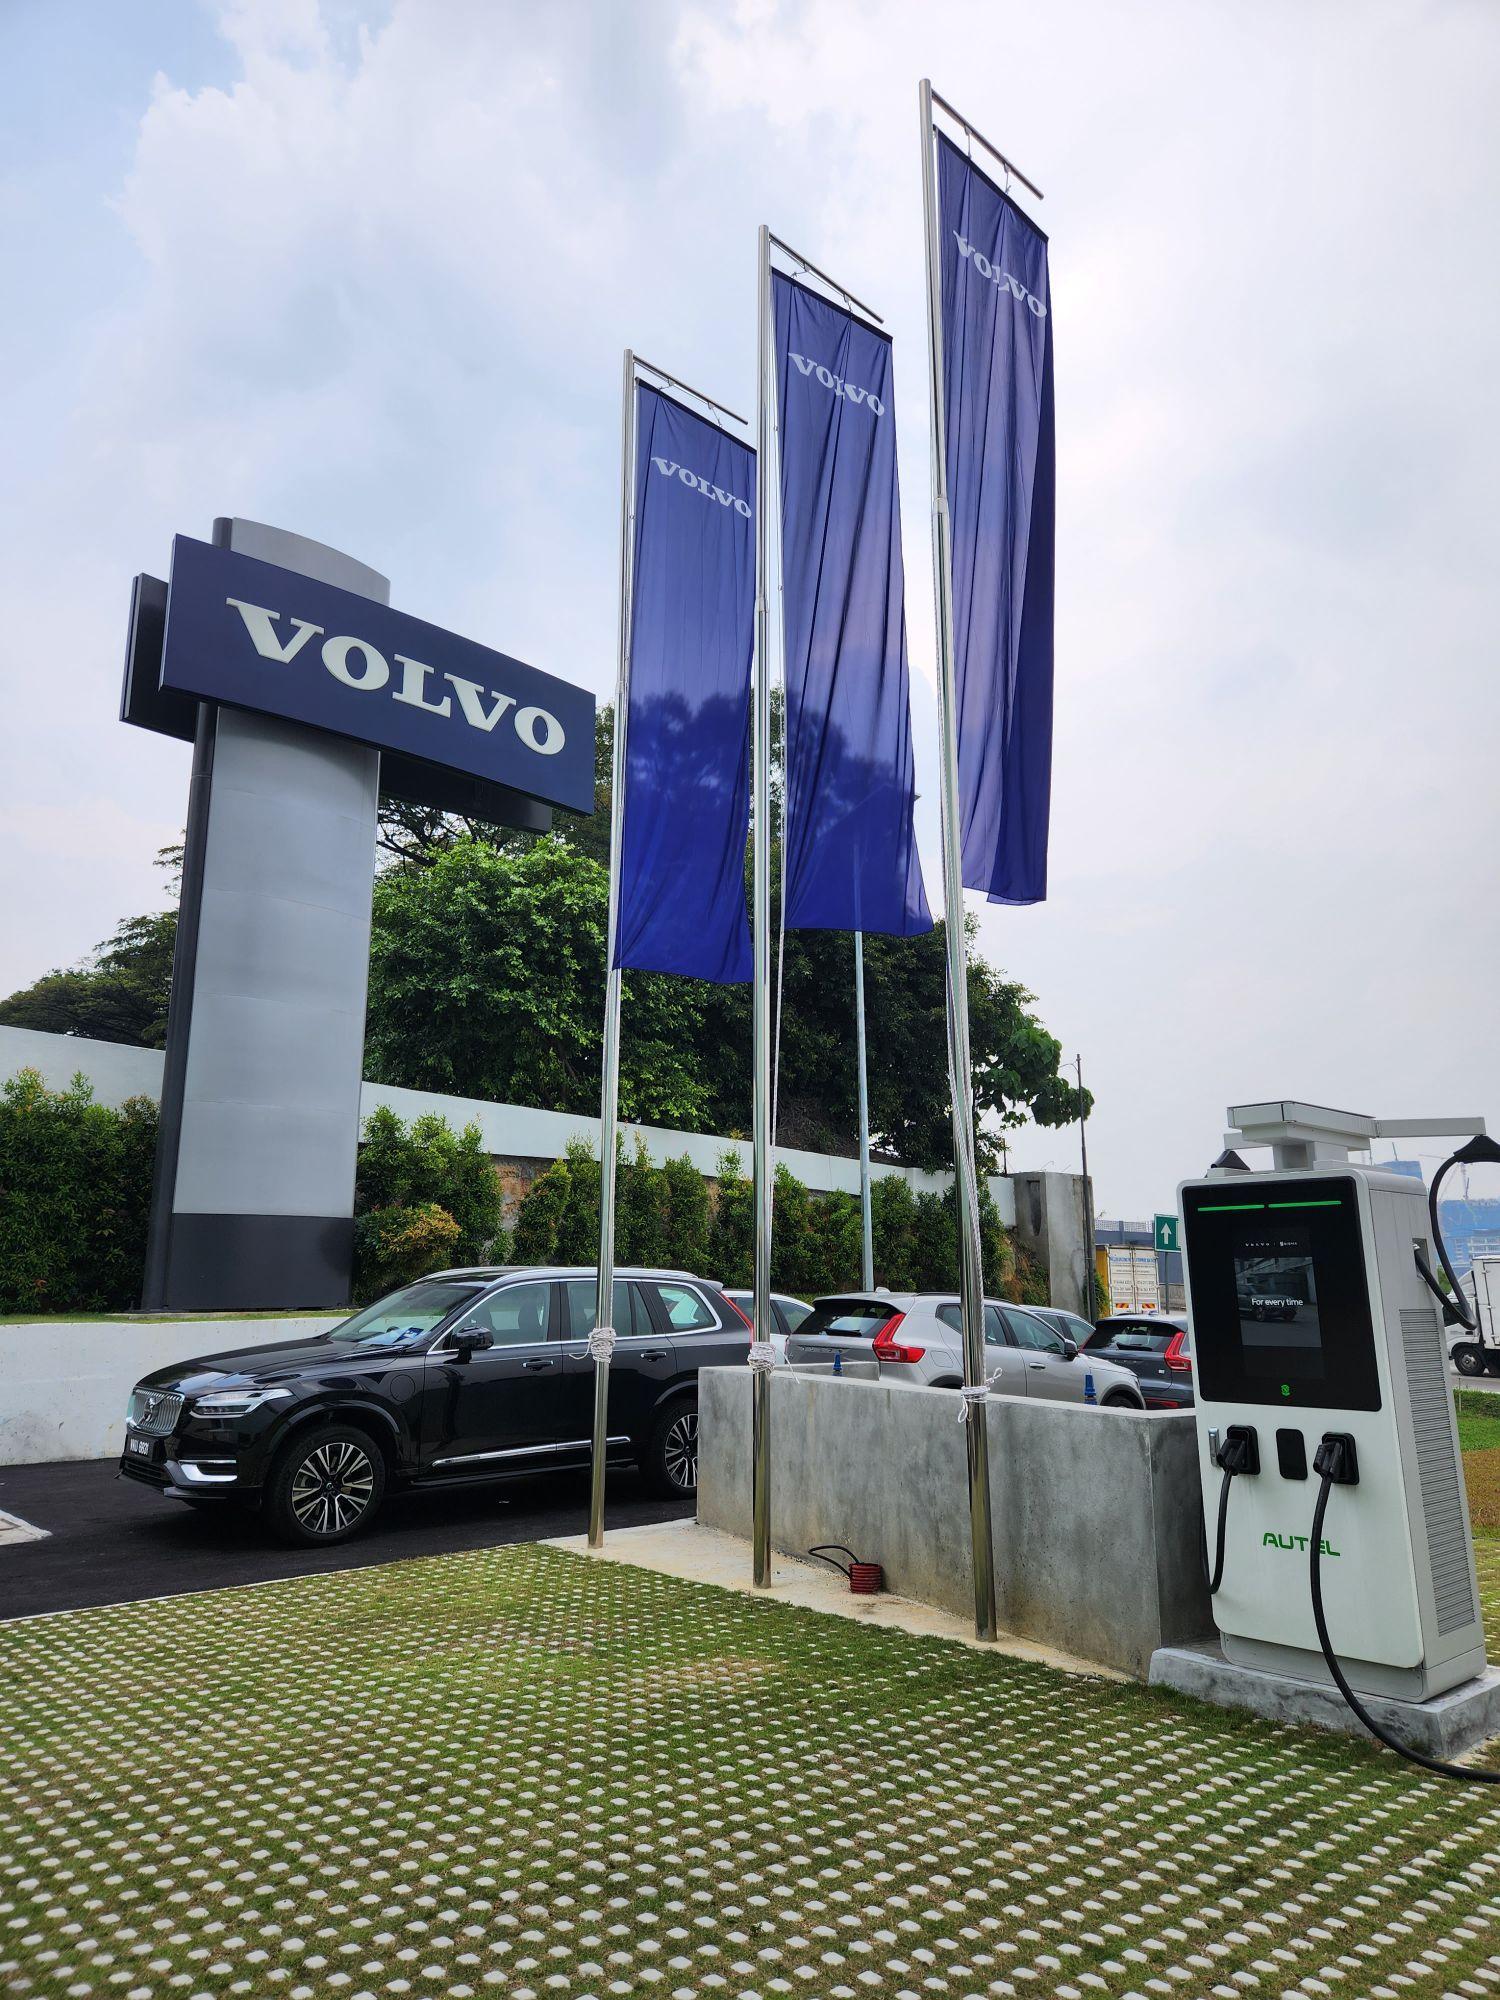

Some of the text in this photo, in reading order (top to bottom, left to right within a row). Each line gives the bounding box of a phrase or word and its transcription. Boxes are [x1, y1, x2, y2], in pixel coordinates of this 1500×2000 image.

[953, 230, 1047, 318] VOLVO
[788, 352, 886, 417] VOLVO
[650, 456, 752, 519] VOLVO
[226, 597, 566, 756] VOLVO
[1251, 1298, 1303, 1307] For every time
